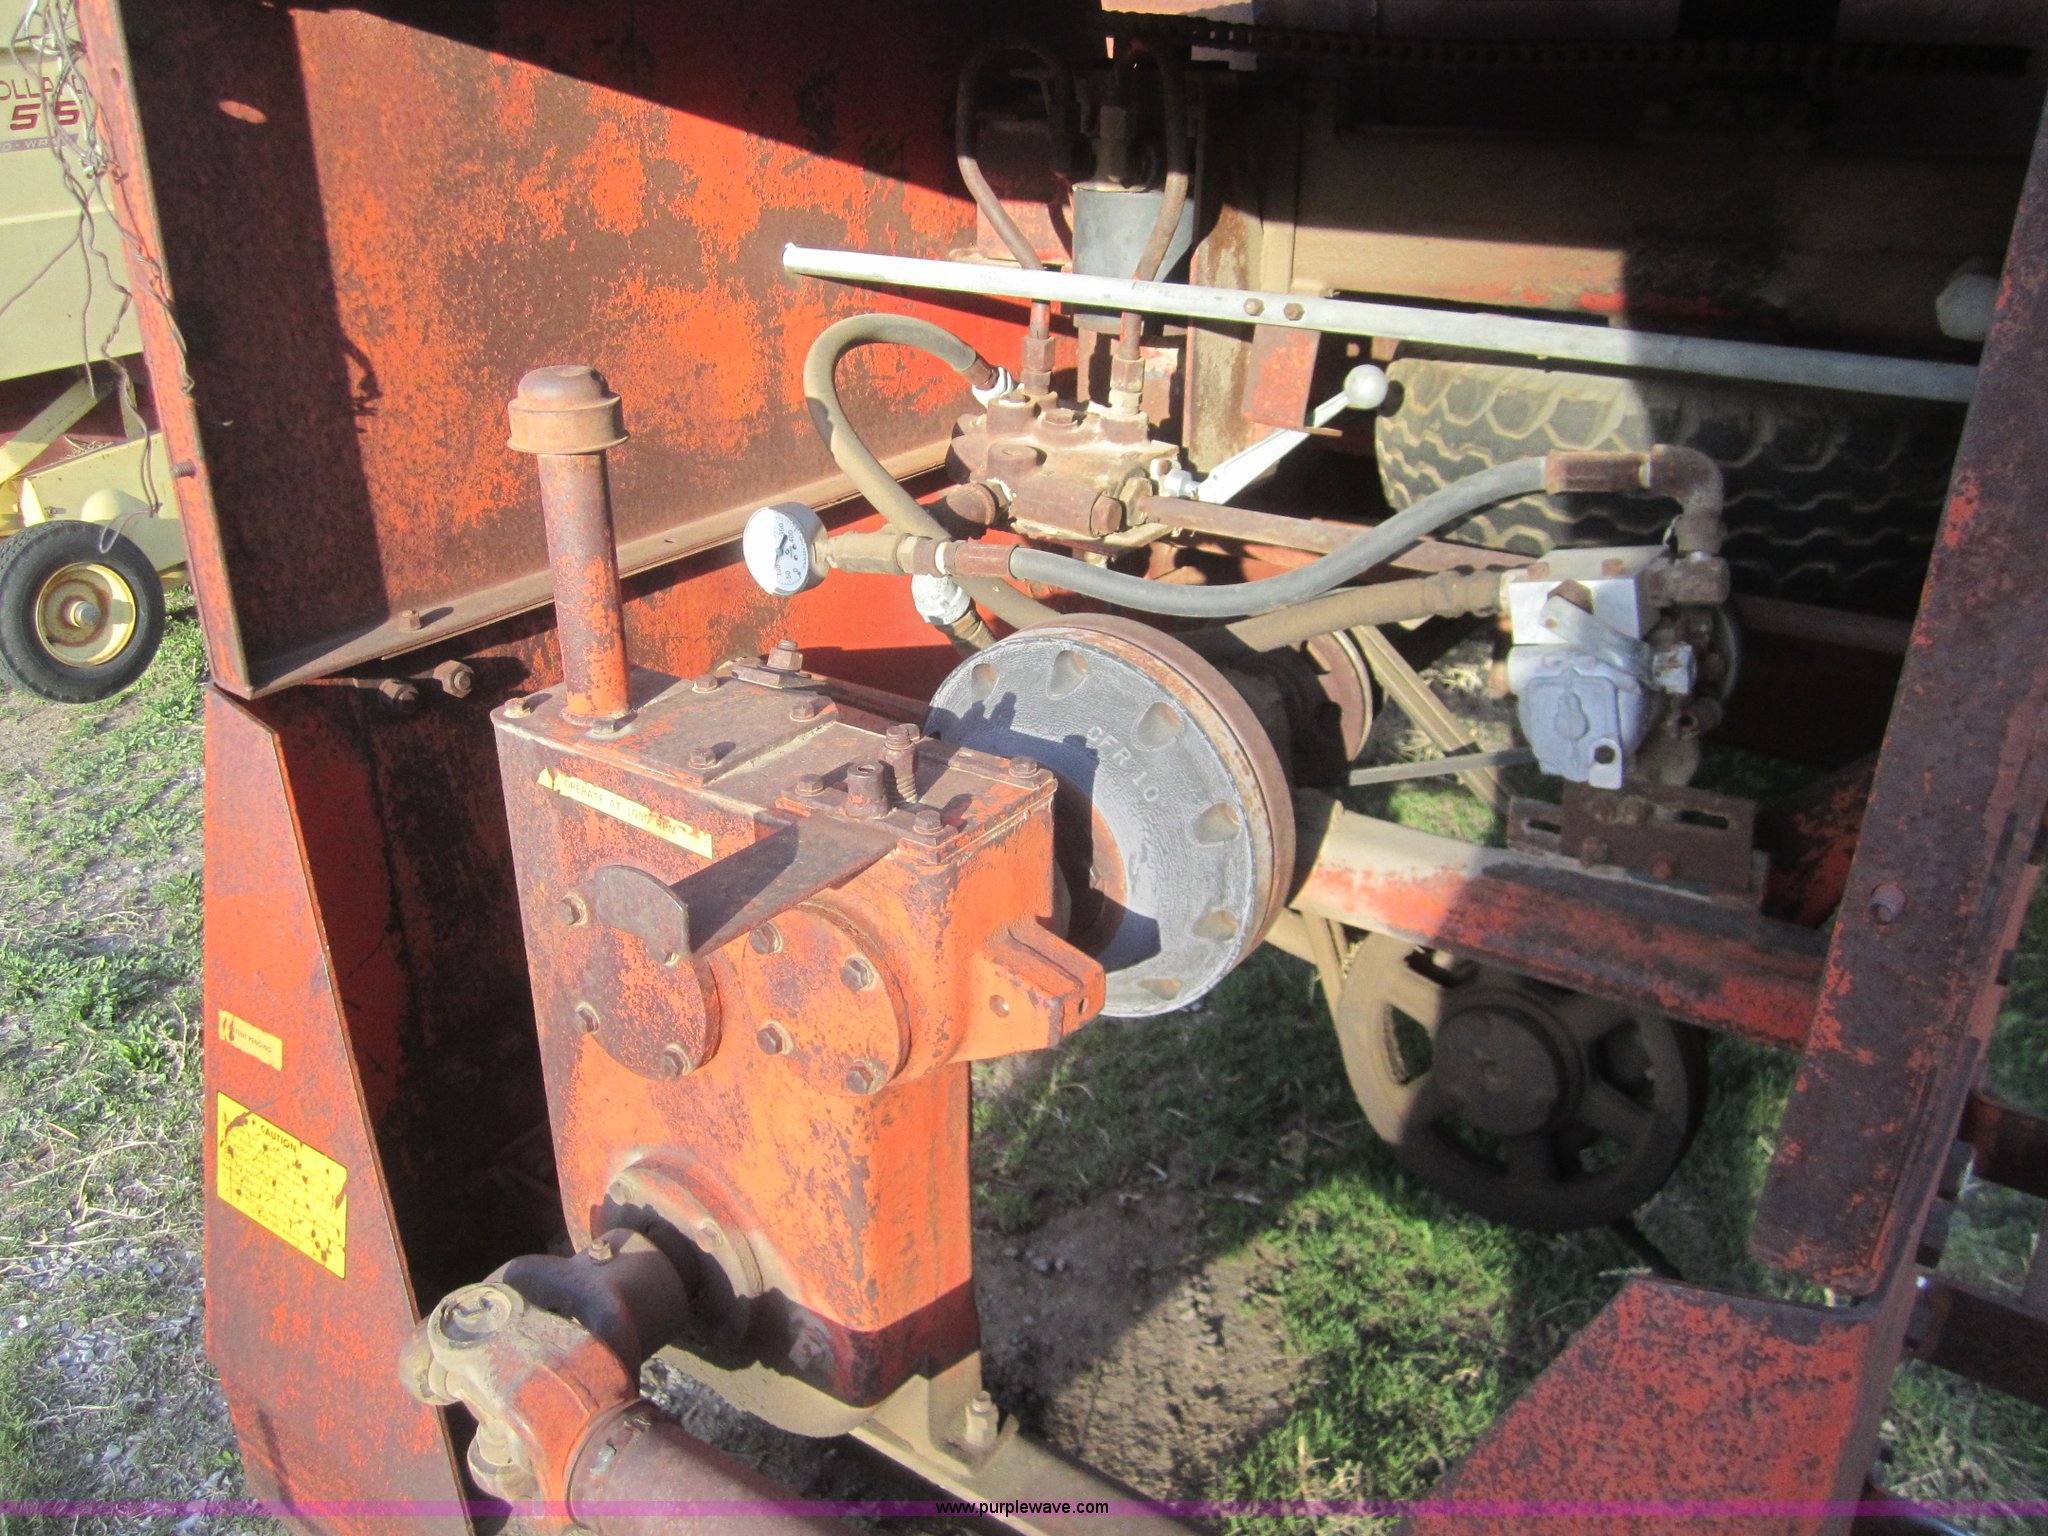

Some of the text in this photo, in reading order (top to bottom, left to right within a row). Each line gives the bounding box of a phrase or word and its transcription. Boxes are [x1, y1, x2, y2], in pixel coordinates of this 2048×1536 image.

[1086, 726, 1131, 766] CFR
[563, 779, 677, 835] OPERATE AT 1000 RPM
[248, 1035, 272, 1053] PENDING
[260, 1124, 297, 1153] CAUTION
